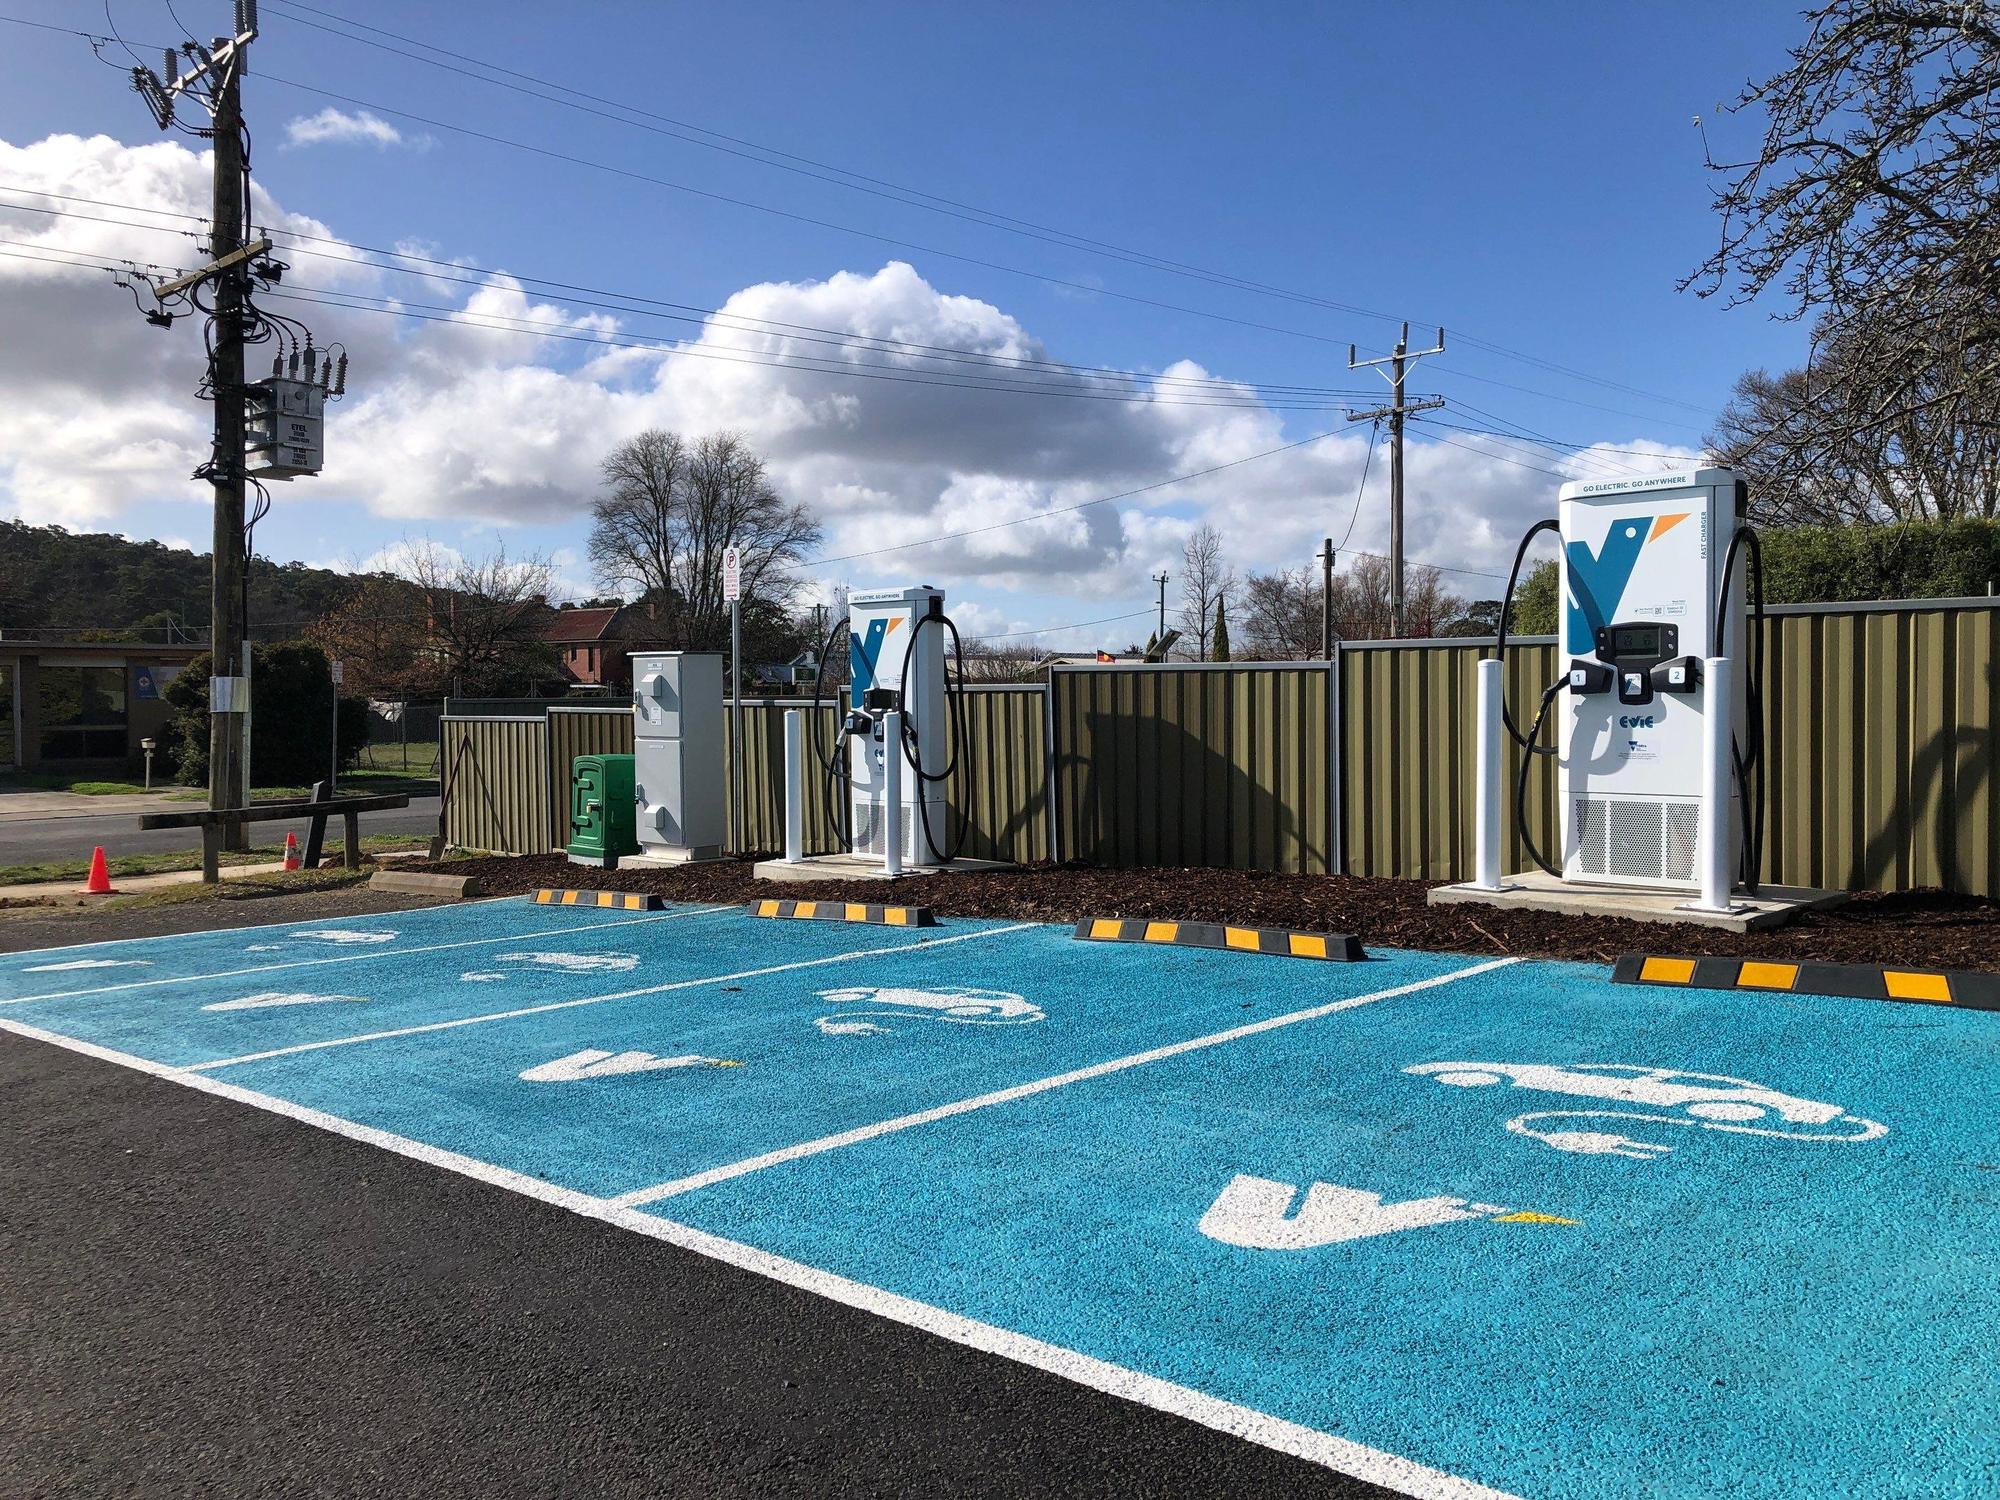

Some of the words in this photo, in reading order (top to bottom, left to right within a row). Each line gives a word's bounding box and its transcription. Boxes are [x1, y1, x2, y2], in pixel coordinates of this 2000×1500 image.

[1595, 482, 1630, 491] ELECTRIC.
[1631, 480, 1643, 488] GO
[1644, 476, 1686, 486] ANYWHERE
